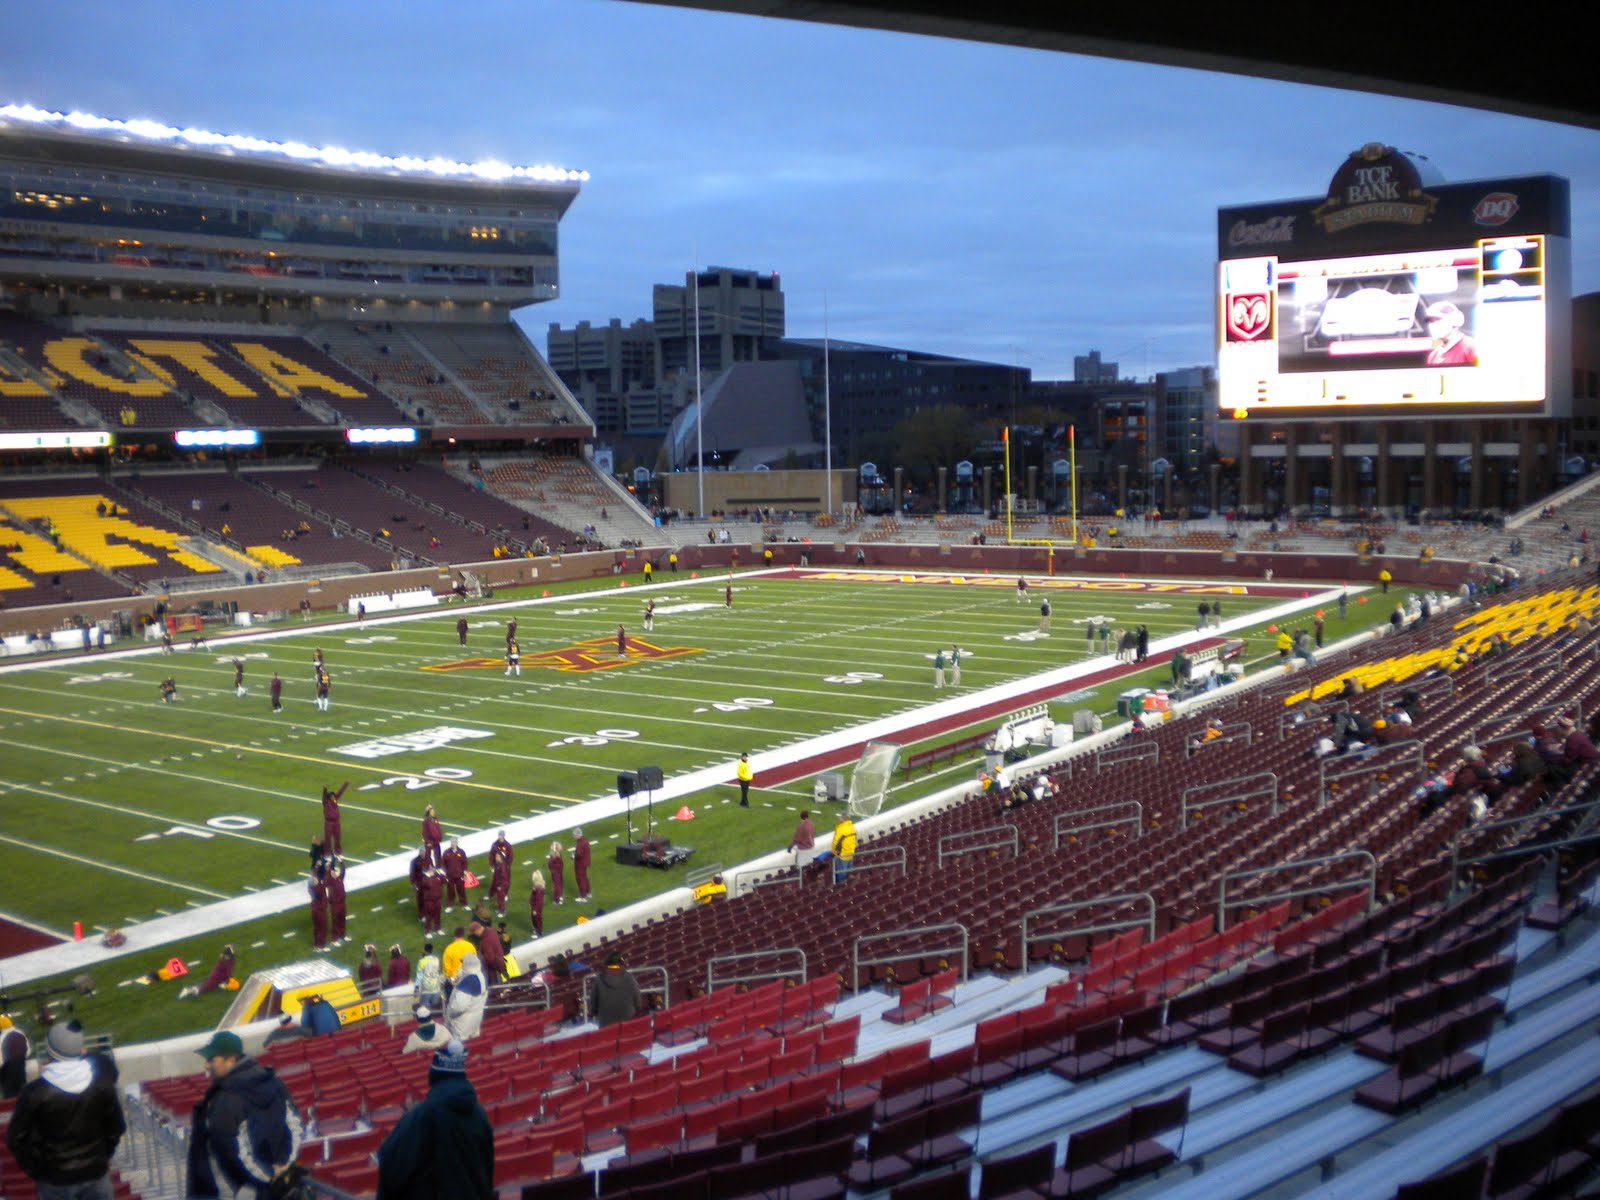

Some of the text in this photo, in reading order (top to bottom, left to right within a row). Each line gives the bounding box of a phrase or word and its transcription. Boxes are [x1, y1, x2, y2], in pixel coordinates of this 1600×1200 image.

[1355, 166, 1393, 185] TCF
[1348, 181, 1400, 203] BANK
[1482, 200, 1511, 217] DQ
[823, 671, 884, 684] 50
[712, 697, 774, 712] 40
[564, 728, 640, 747] 30
[382, 767, 473, 790] 20
[163, 815, 262, 838] 10
